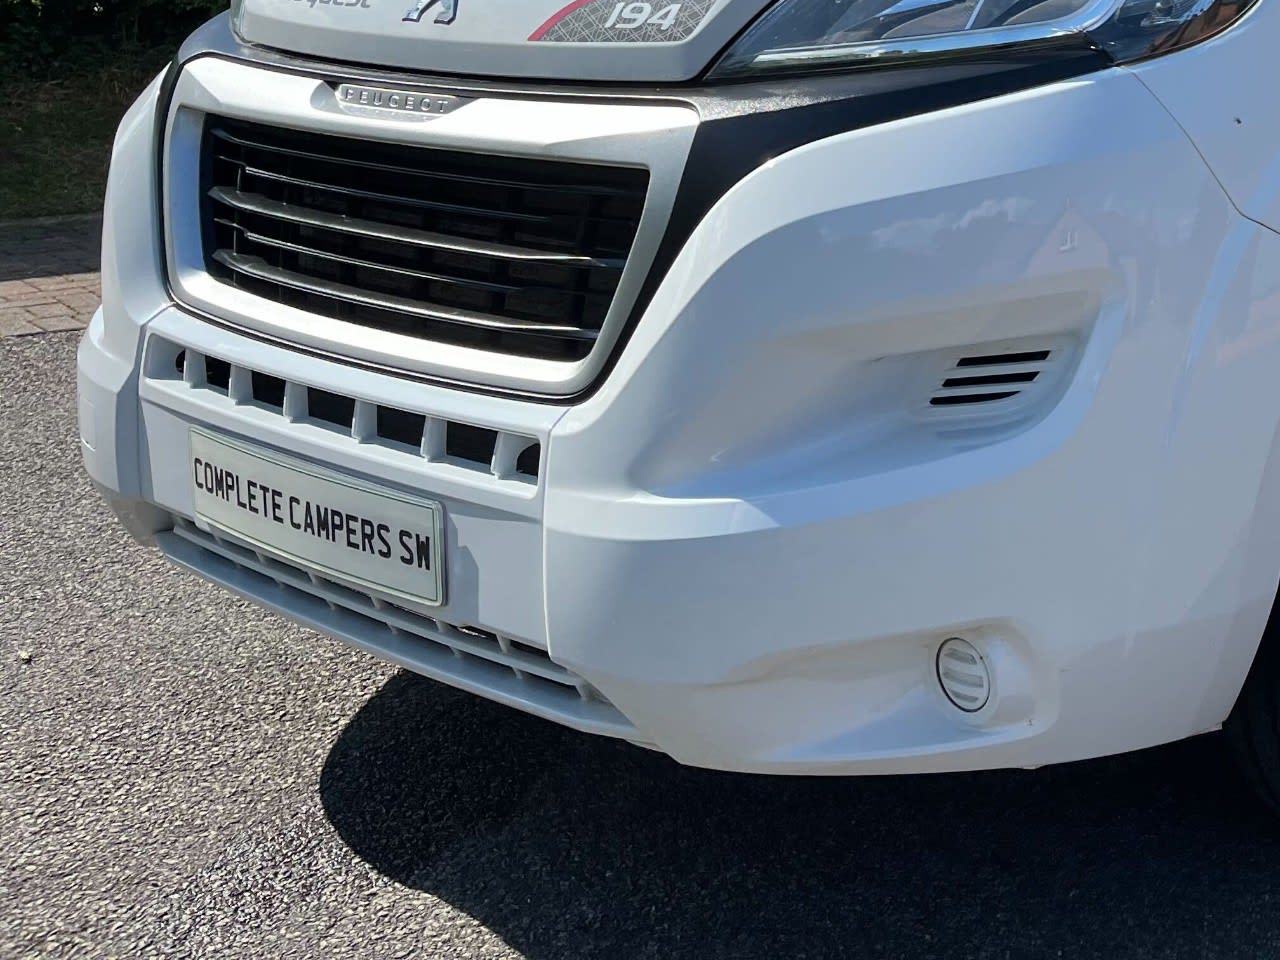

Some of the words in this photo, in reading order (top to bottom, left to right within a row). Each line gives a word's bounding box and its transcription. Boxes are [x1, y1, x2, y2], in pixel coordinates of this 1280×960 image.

[604, 2, 681, 30] 194
[345, 88, 449, 113] PEUGEOT
[194, 457, 284, 525] COMPLETE
[289, 496, 391, 559] CAMPERS
[399, 529, 431, 571] SW
